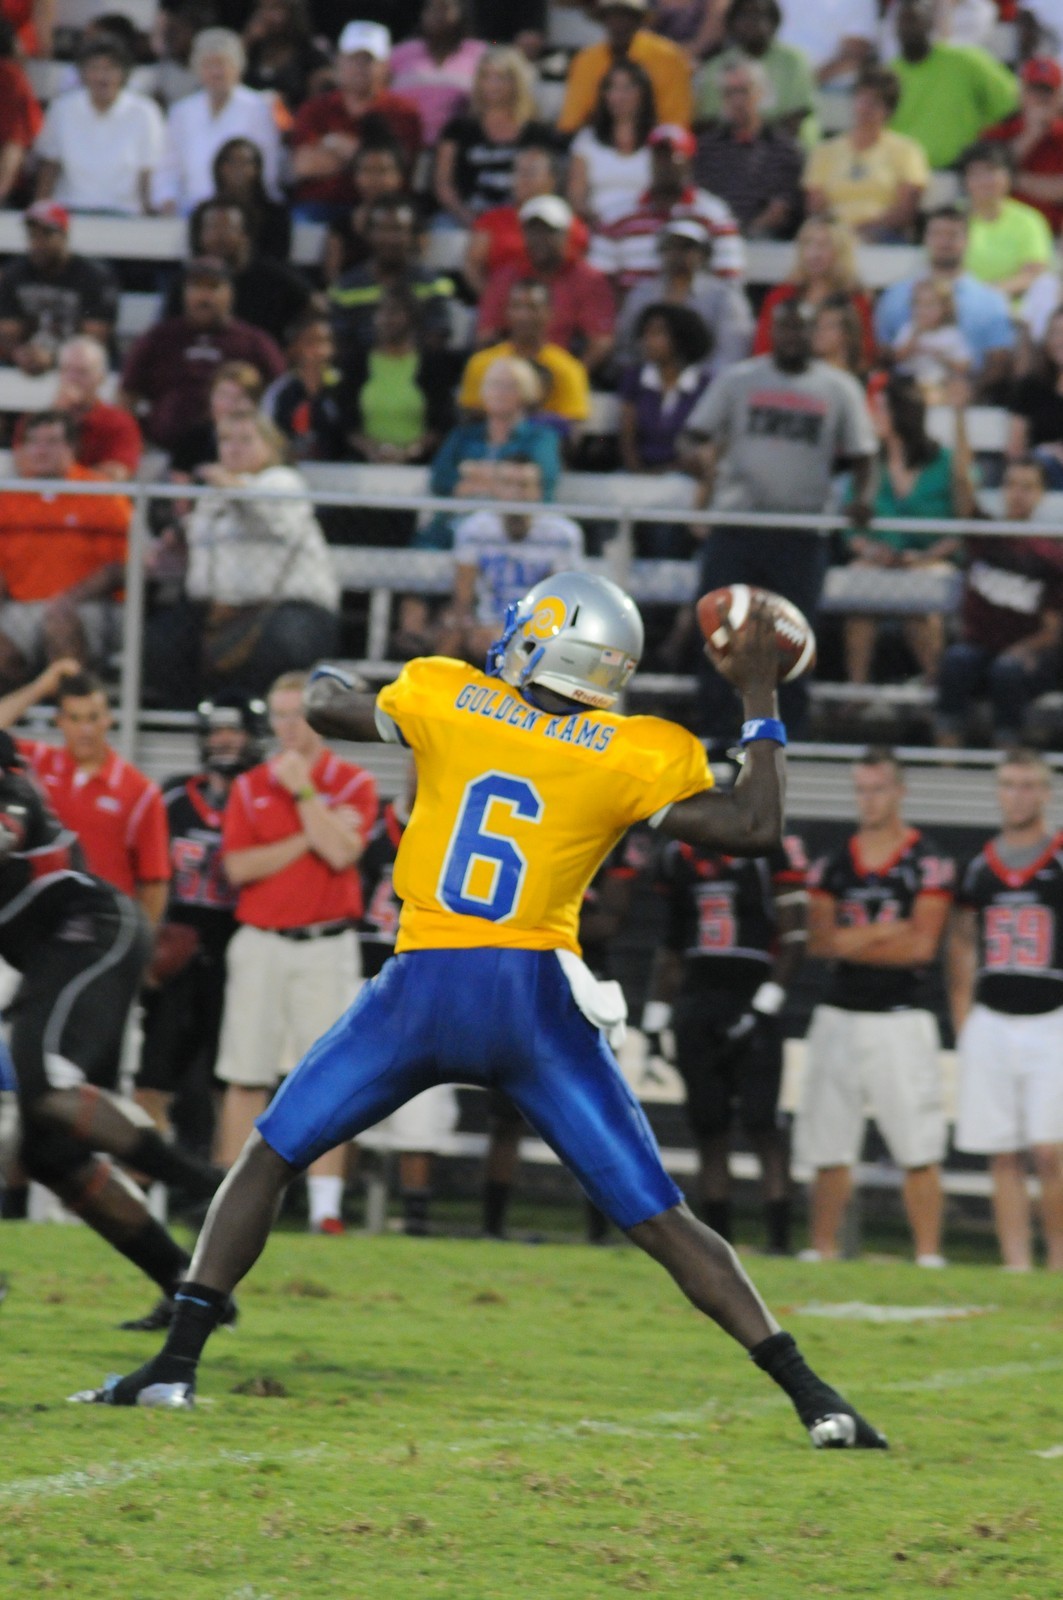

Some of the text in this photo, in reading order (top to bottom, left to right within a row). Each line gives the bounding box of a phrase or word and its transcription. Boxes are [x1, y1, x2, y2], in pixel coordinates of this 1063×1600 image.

[455, 684, 616, 752] GOLDEN RAMS
[435, 768, 545, 924] 6
[697, 892, 737, 952] 5
[983, 903, 1055, 971] 59
